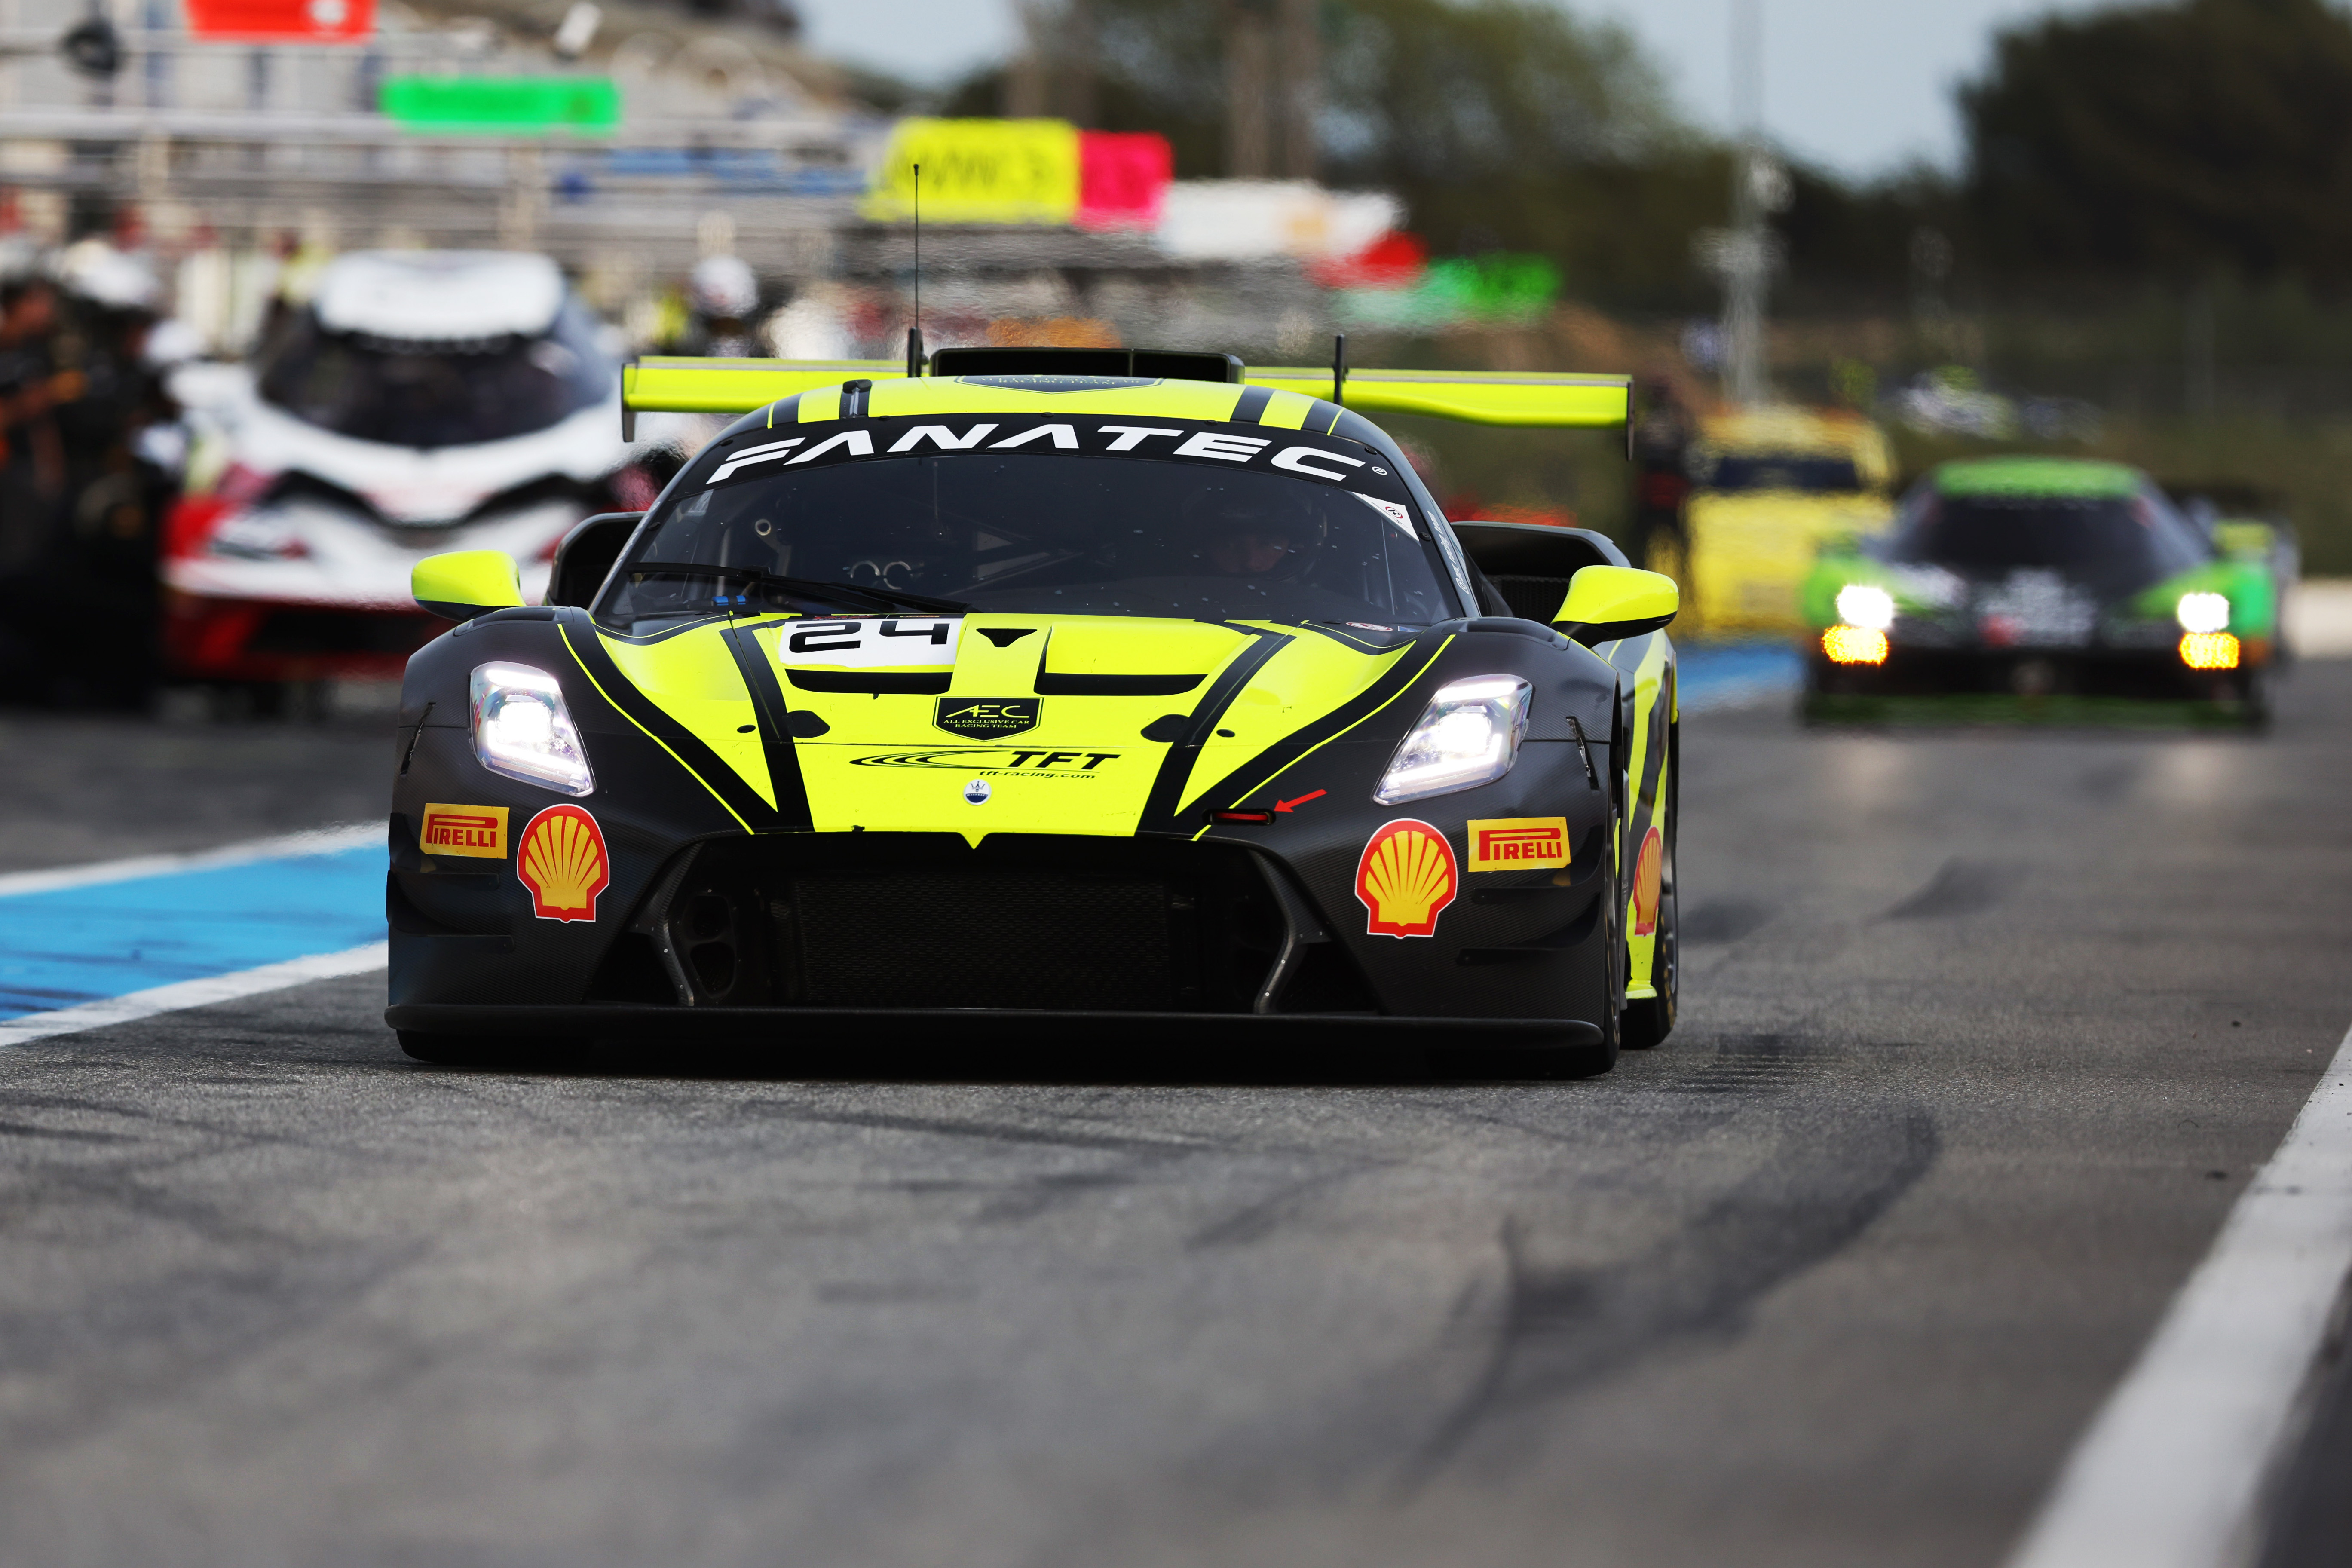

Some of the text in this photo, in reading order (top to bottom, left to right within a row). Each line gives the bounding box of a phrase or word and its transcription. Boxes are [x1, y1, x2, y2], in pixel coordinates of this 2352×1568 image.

[706, 424, 1366, 484] FANATEC
[789, 621, 950, 653] 24
[979, 770, 1096, 779] tft-racing.com
[1008, 751, 1121, 770] TFT
[426, 814, 498, 848] PIRELLI
[1479, 827, 1562, 861] PIRELLI
